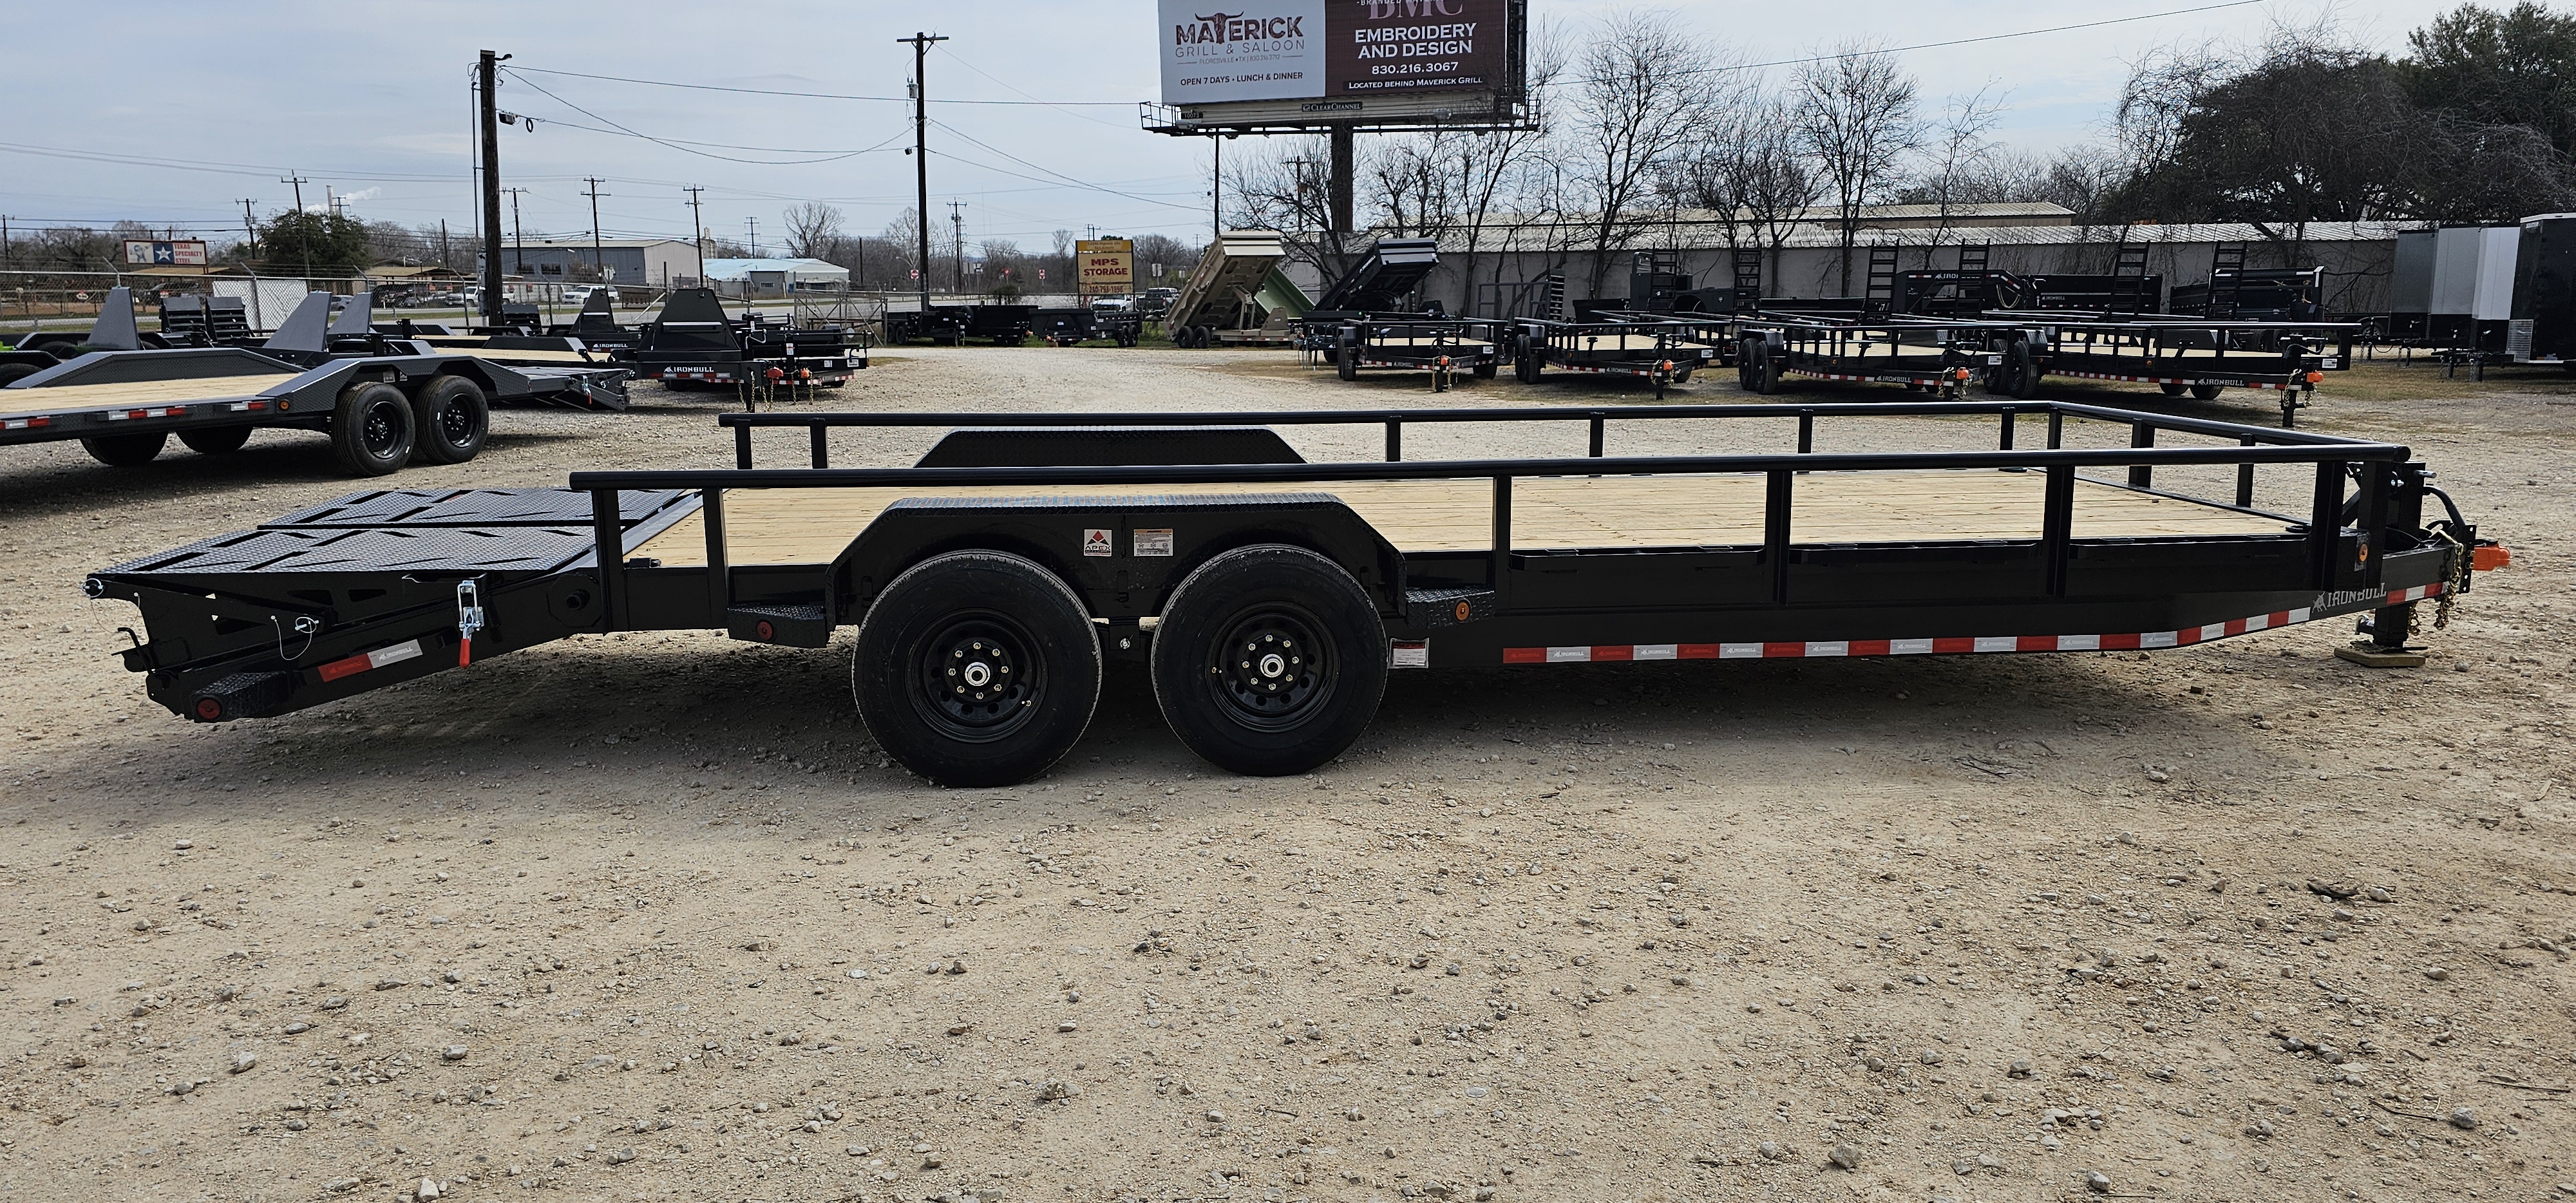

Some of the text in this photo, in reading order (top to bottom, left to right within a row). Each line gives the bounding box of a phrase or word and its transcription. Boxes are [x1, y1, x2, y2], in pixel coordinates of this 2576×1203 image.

[1355, 23, 1477, 43] EMBROIDERY
[1175, 39, 1304, 57] GRILL & SALOON
[1358, 40, 1472, 59] AND DESIGN
[1372, 61, 1459, 75] 830.216.3067
[1180, 77, 1201, 86] OPEN
[1210, 75, 1230, 84] DAYS
[1236, 74, 1264, 82] LUNCH
[1084, 268, 1128, 276] STORAGE
[2327, 582, 2387, 607] IRONBULL
